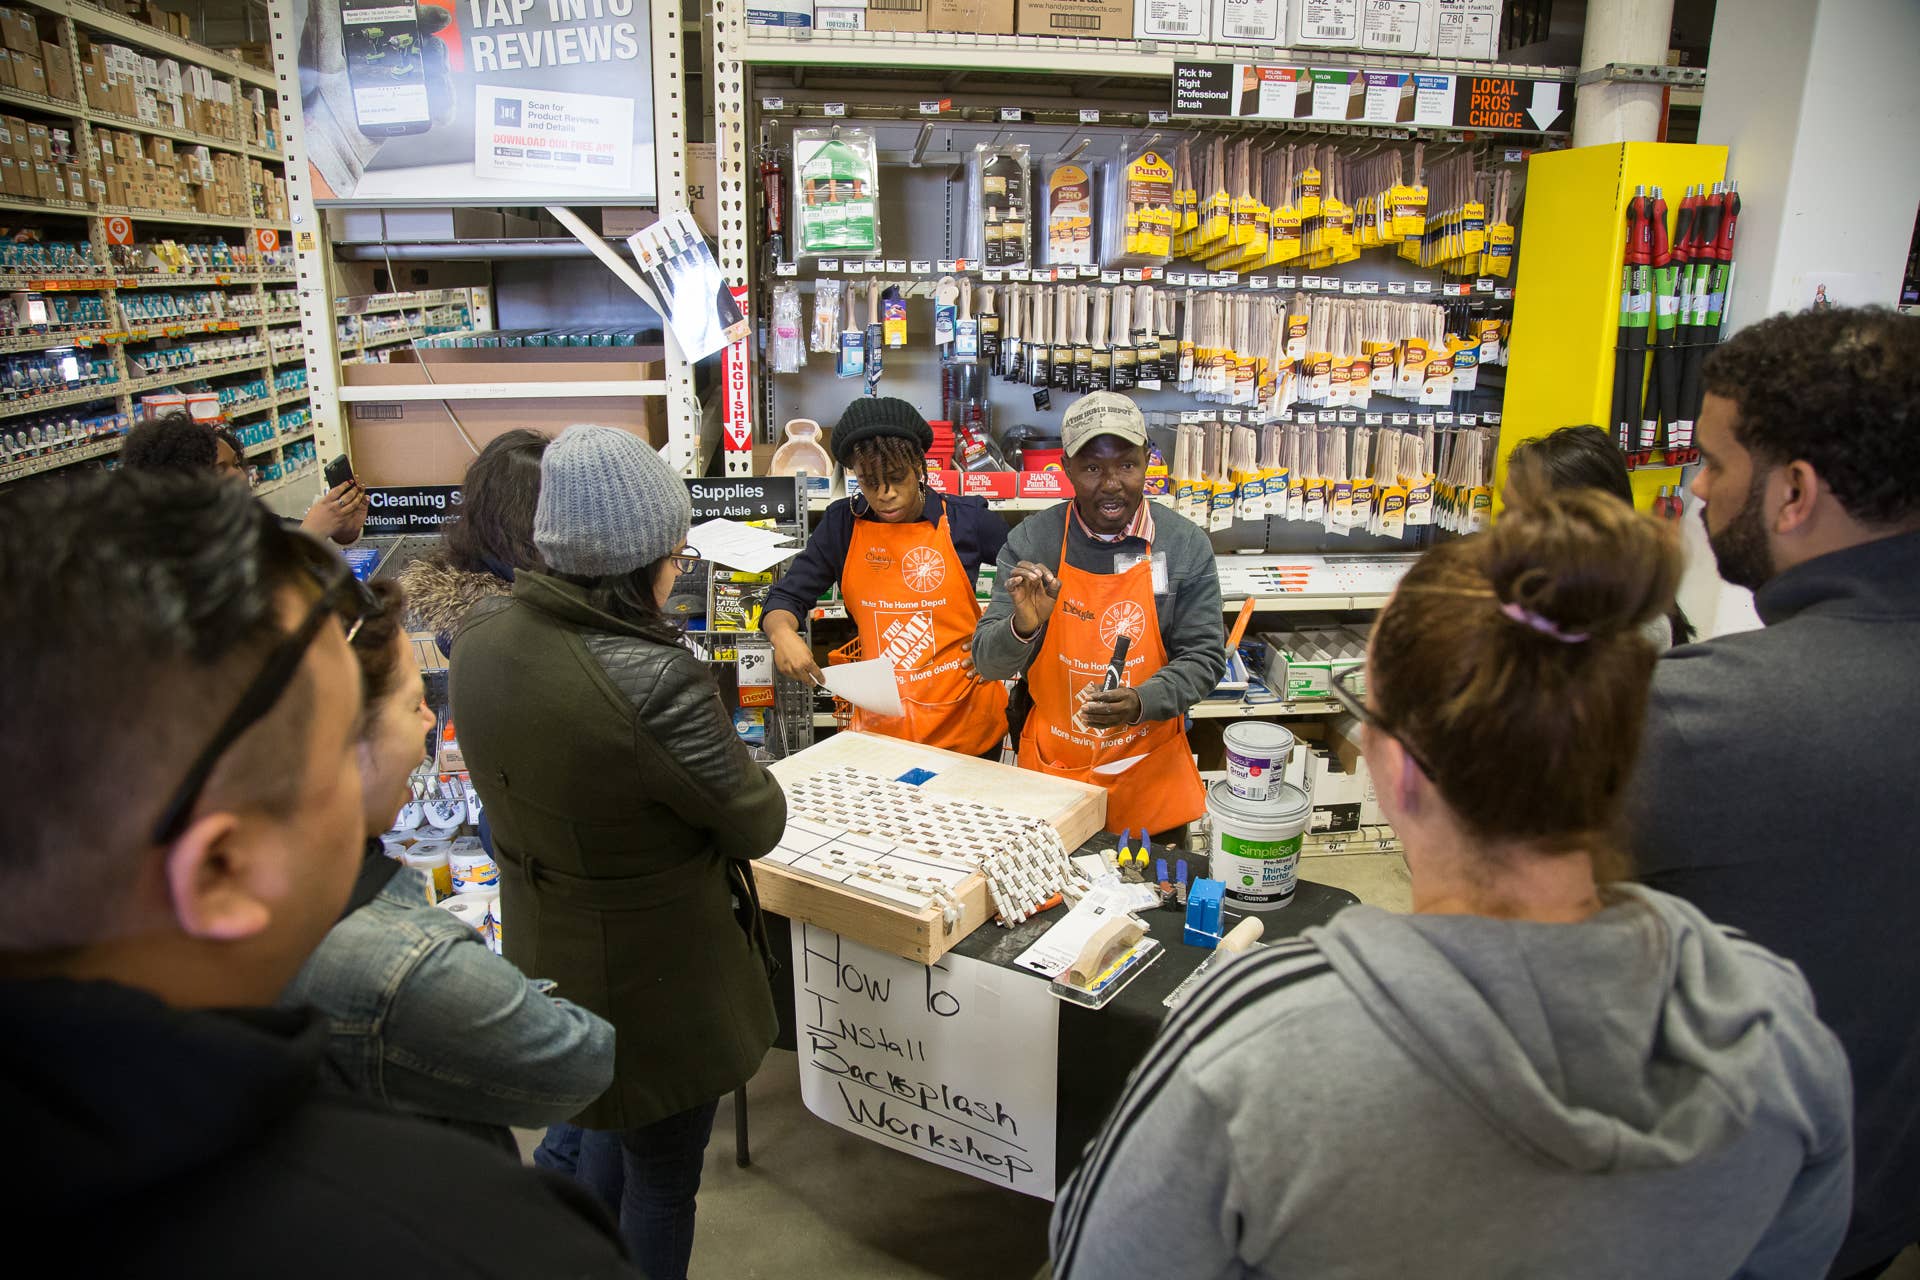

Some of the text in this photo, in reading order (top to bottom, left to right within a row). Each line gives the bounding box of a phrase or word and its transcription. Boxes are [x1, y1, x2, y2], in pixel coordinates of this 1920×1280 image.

[1028, 3, 1122, 13] www.handypaintproducts.com
[1372, 1, 1390, 10] 780
[1446, 15, 1464, 24] 780
[470, 23, 639, 73] REVIEWS
[1178, 68, 1212, 78] Pick the
[1178, 79, 1201, 89] Right
[1472, 78, 1519, 97] LOCAL
[1177, 89, 1229, 100] Professional
[528, 101, 564, 111] Scan for
[1177, 100, 1202, 109] Brush
[1470, 94, 1511, 111] PROS
[528, 111, 562, 121] Product
[1469, 110, 1523, 128] CHOICE
[528, 122, 544, 130] and
[493, 134, 546, 147] DOWNLOAD
[1135, 166, 1169, 178] Purdy
[1058, 191, 1082, 200] PRO
[1277, 217, 1300, 225] Purdy
[1428, 365, 1451, 373] PRO
[732, 342, 746, 439] TINGUISHER
[691, 484, 764, 501] Supplies
[370, 492, 446, 509] Cleaning
[705, 508, 720, 516] on
[723, 506, 751, 516] Aisle
[760, 504, 768, 514] 3
[777, 504, 785, 514] 6
[364, 514, 407, 526] ditional
[879, 598, 946, 609] The Home Depot
[715, 606, 745, 614] GLOVES
[881, 618, 904, 642] THE
[880, 611, 932, 668] HOME
[900, 631, 935, 671] DEPOT
[1073, 658, 1089, 669] The
[1091, 662, 1110, 671] Hom
[1125, 655, 1145, 667] epot
[910, 670, 932, 682] More
[742, 689, 772, 704] new!
[1050, 725, 1070, 740] More
[1100, 738, 1124, 750] More
[1230, 766, 1249, 779] Grout
[1239, 844, 1294, 858] SimpleSet
[1263, 862, 1294, 874] Thin-Set
[1262, 872, 1289, 881] Mortar
[838, 1082, 1033, 1183] Workshop
